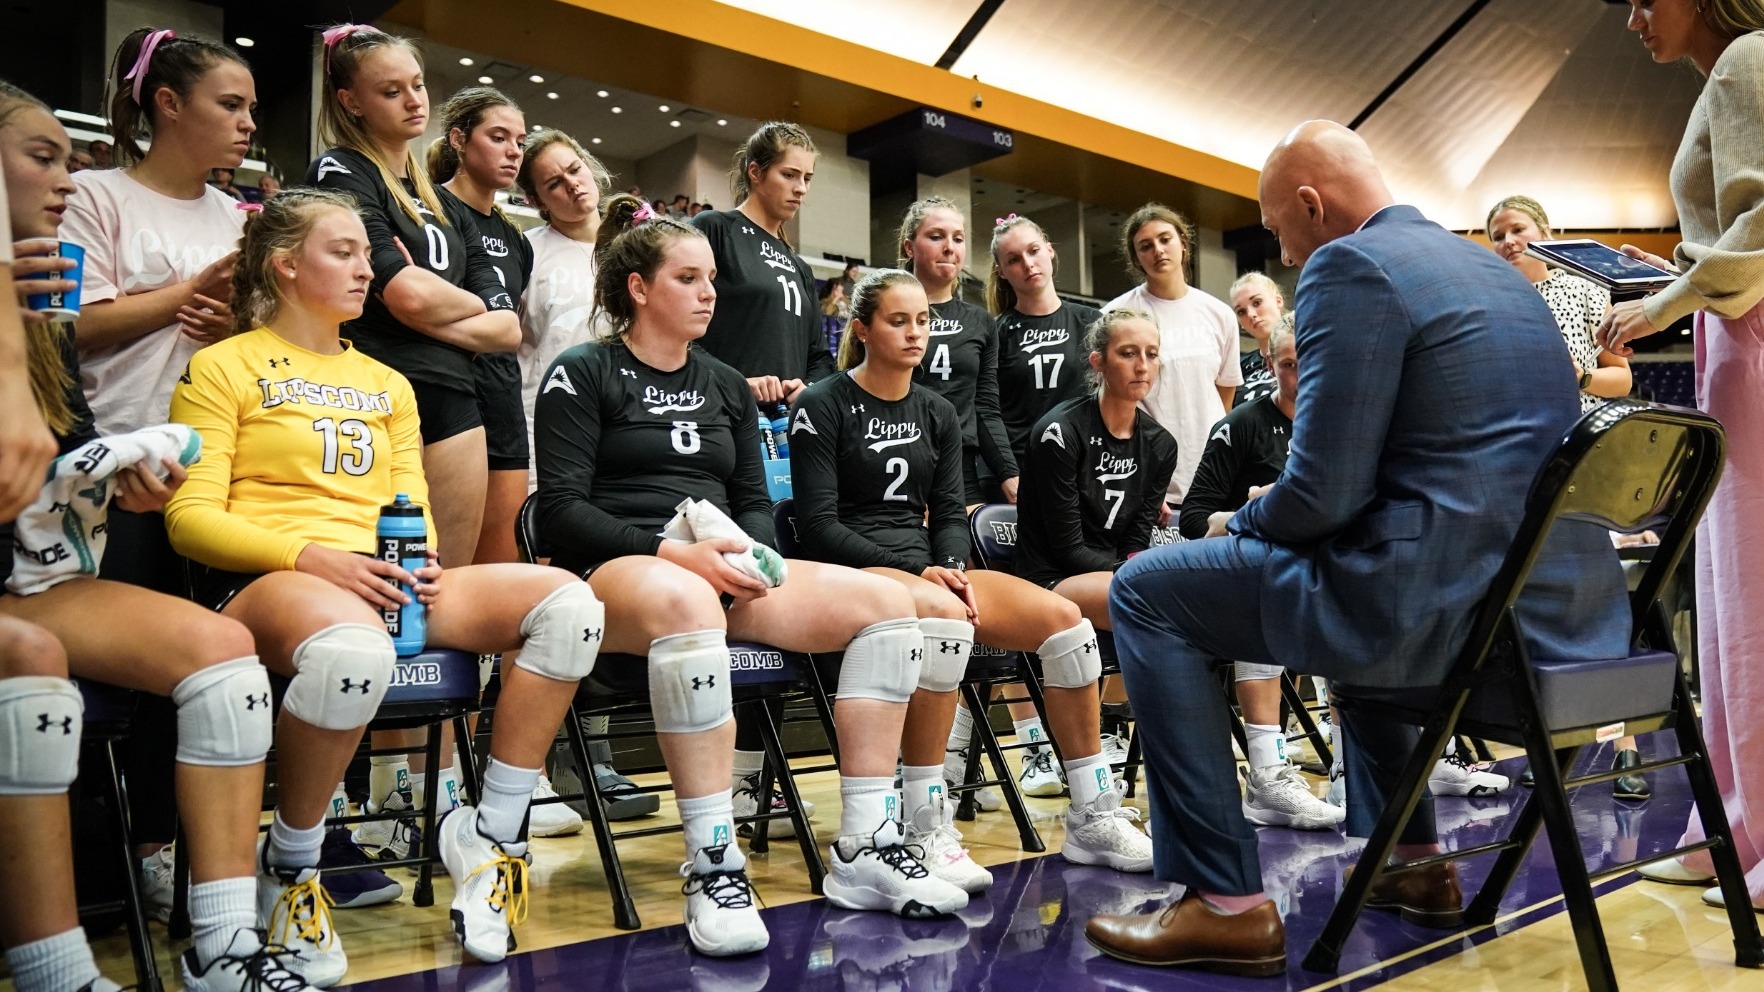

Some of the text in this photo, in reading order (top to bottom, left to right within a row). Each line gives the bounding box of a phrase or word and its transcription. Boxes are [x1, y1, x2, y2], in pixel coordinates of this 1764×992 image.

[924, 112, 946, 129] 104
[992, 131, 1013, 148] 103
[424, 223, 450, 271] 0
[759, 240, 796, 273] Lippy
[776, 274, 802, 317] 11
[1018, 328, 1070, 354] Lippy
[929, 343, 952, 381] 4
[1027, 353, 1065, 390] 17
[642, 385, 706, 415] Lippy
[312, 416, 375, 477] 13
[670, 420, 701, 455] 8
[764, 429, 778, 460] POWE
[864, 417, 922, 454] Lippy
[883, 456, 909, 502] 2
[1095, 451, 1138, 485] Lippy
[1103, 488, 1125, 530] 7
